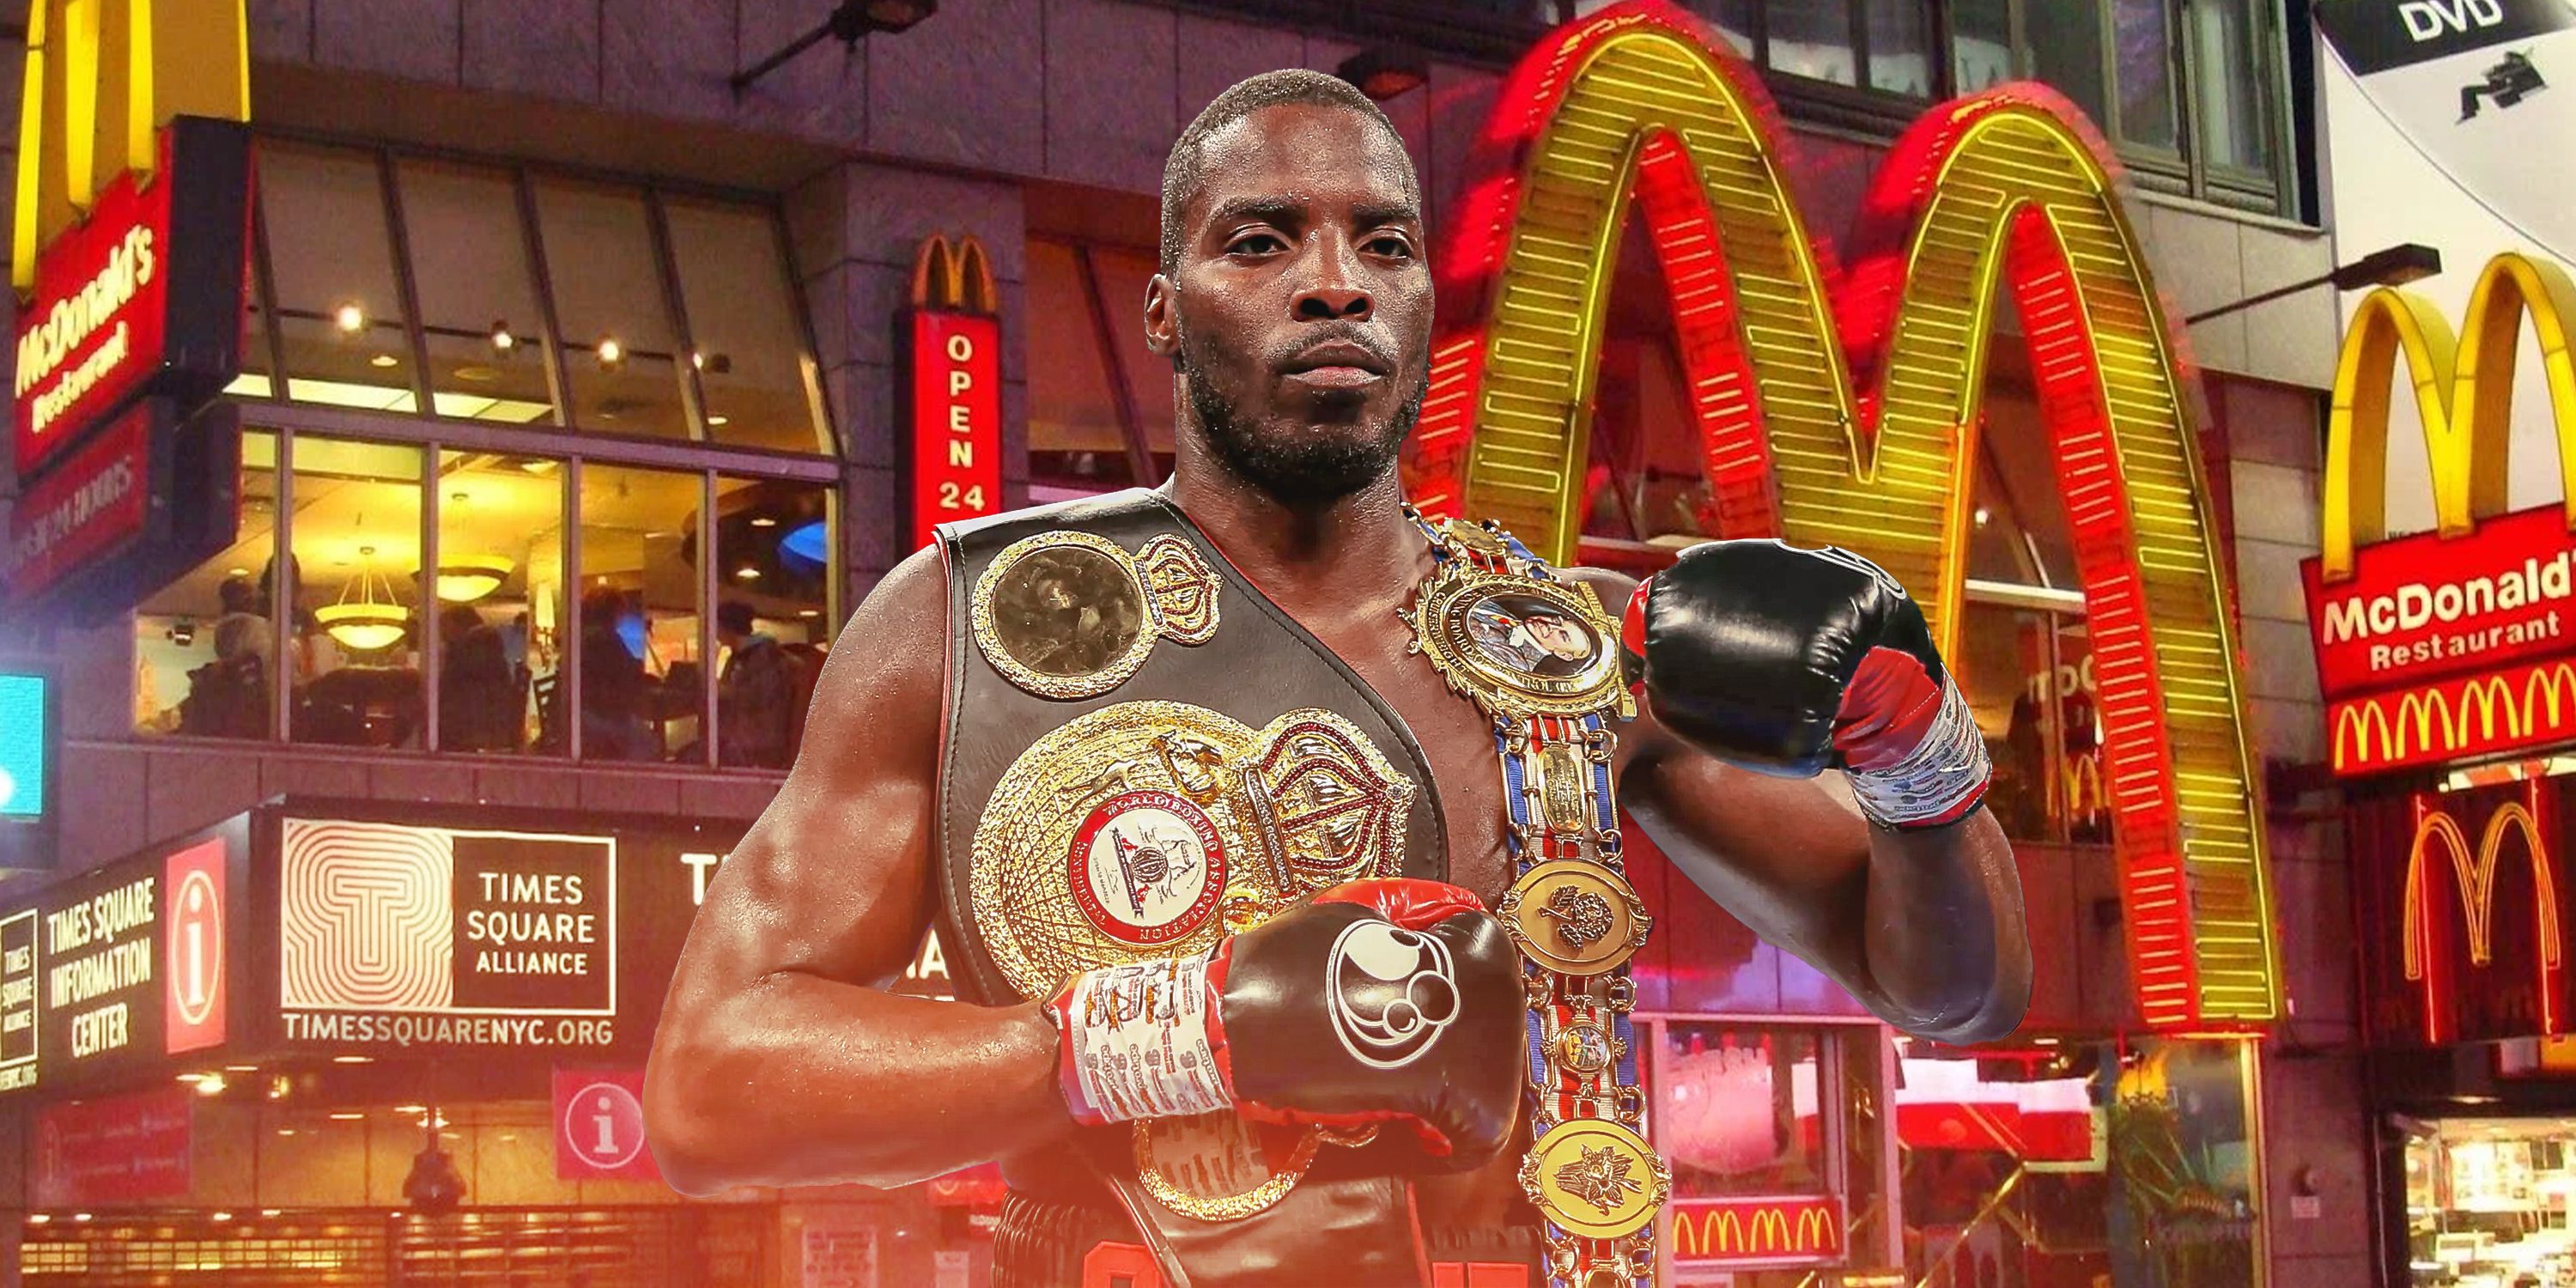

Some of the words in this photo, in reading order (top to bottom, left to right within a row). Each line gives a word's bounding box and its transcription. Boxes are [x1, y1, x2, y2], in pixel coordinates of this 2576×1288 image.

[2398, 0, 2503, 41] DVD
[15, 224, 154, 398] McDonald's
[32, 320, 129, 434] Restaurant
[947, 334, 974, 468] OPEN
[939, 482, 986, 512] 24
[2370, 611, 2561, 671] Restaurant
[47, 901, 92, 955] TIMES
[93, 877, 155, 944] SQUARE
[478, 872, 583, 905] TIMES
[466, 910, 595, 946] SQUARE
[51, 937, 151, 1010] INFORMATION
[475, 951, 587, 975] ALLIANCE
[71, 1002, 128, 1058] CENTER
[281, 1012, 613, 1046] TIMESSQUARENYC.ORG
